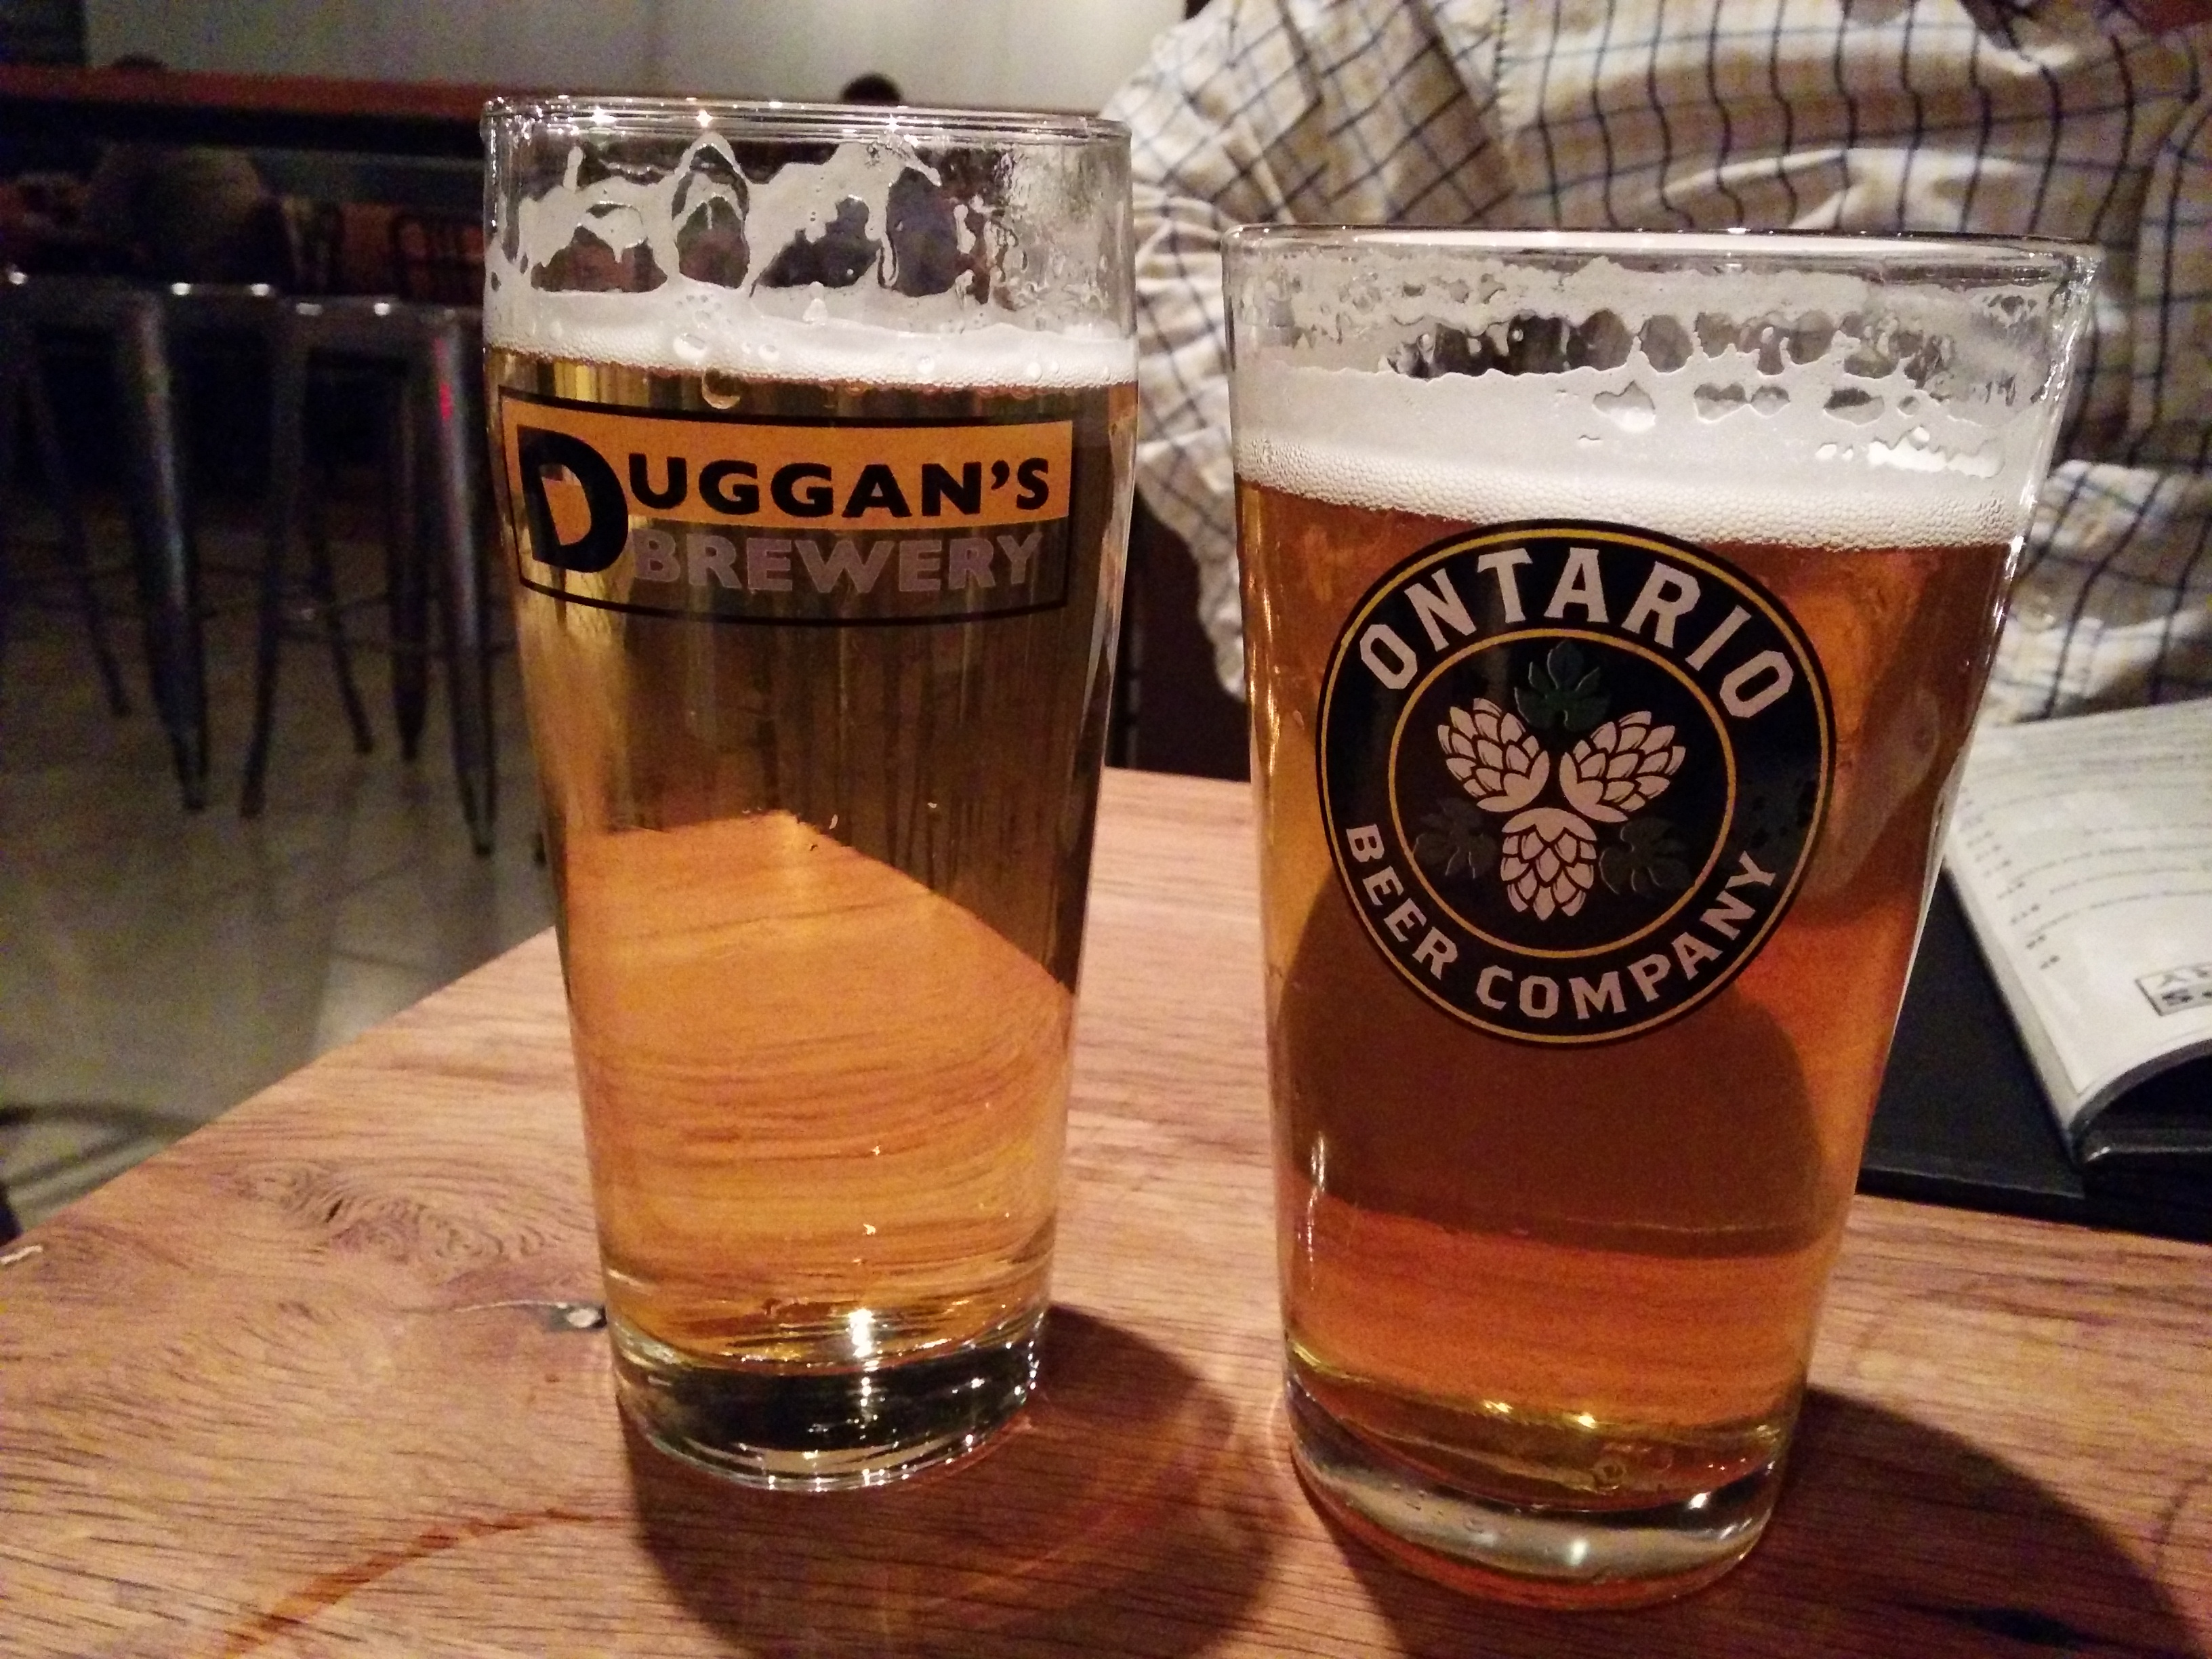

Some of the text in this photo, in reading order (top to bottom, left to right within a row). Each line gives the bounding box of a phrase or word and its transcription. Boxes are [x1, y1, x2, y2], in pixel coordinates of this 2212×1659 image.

[516, 424, 1049, 573] DUGGAN'S
[630, 527, 1042, 593] BREWERY
[1359, 547, 1794, 718] ONTARIO
[1347, 824, 1776, 1020] BEER COMPANY
